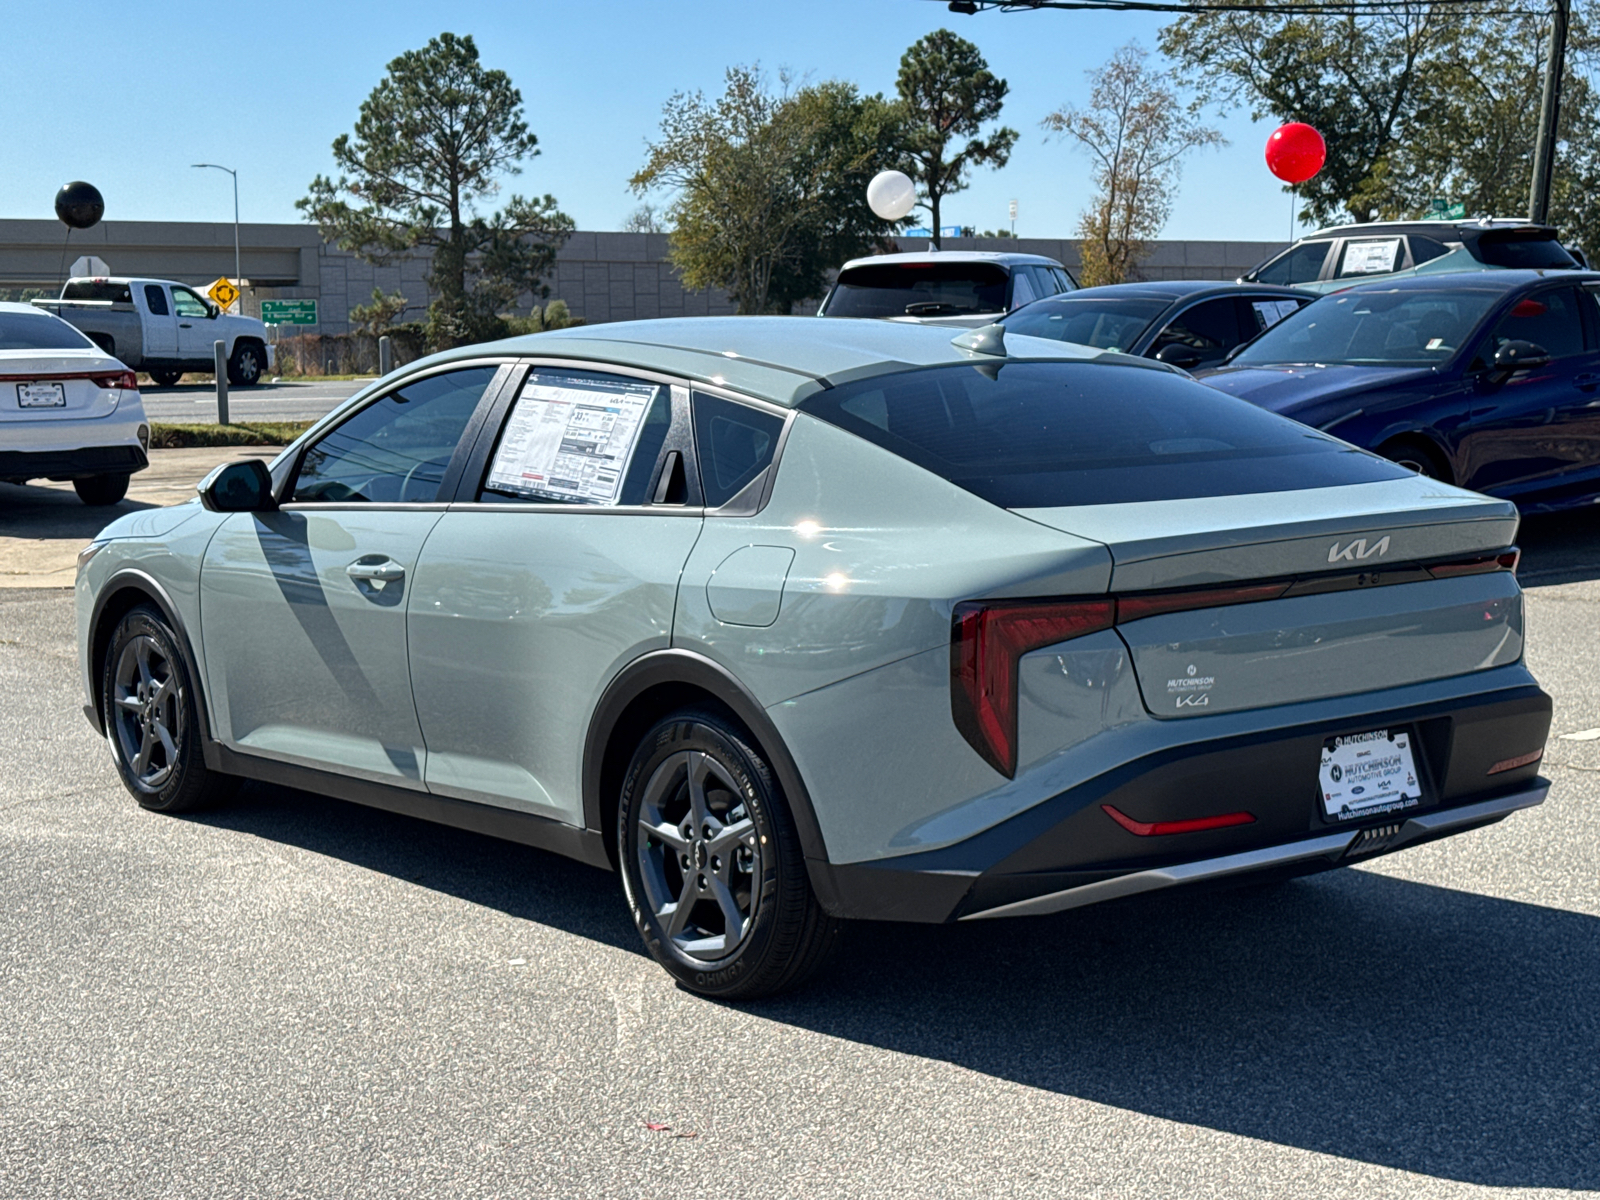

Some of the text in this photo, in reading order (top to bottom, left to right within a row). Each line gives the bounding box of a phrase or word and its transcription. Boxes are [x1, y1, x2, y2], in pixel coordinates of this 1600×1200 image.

[1328, 535, 1391, 563] KIA
[1167, 676, 1215, 688] HUTCHINSON
[1175, 693, 1209, 708] K4
[1343, 729, 1388, 746] HUTCHINSON
[1344, 755, 1403, 777] HUTCHINSON
[1347, 766, 1402, 784] AUTOMOTIVE GROUP
